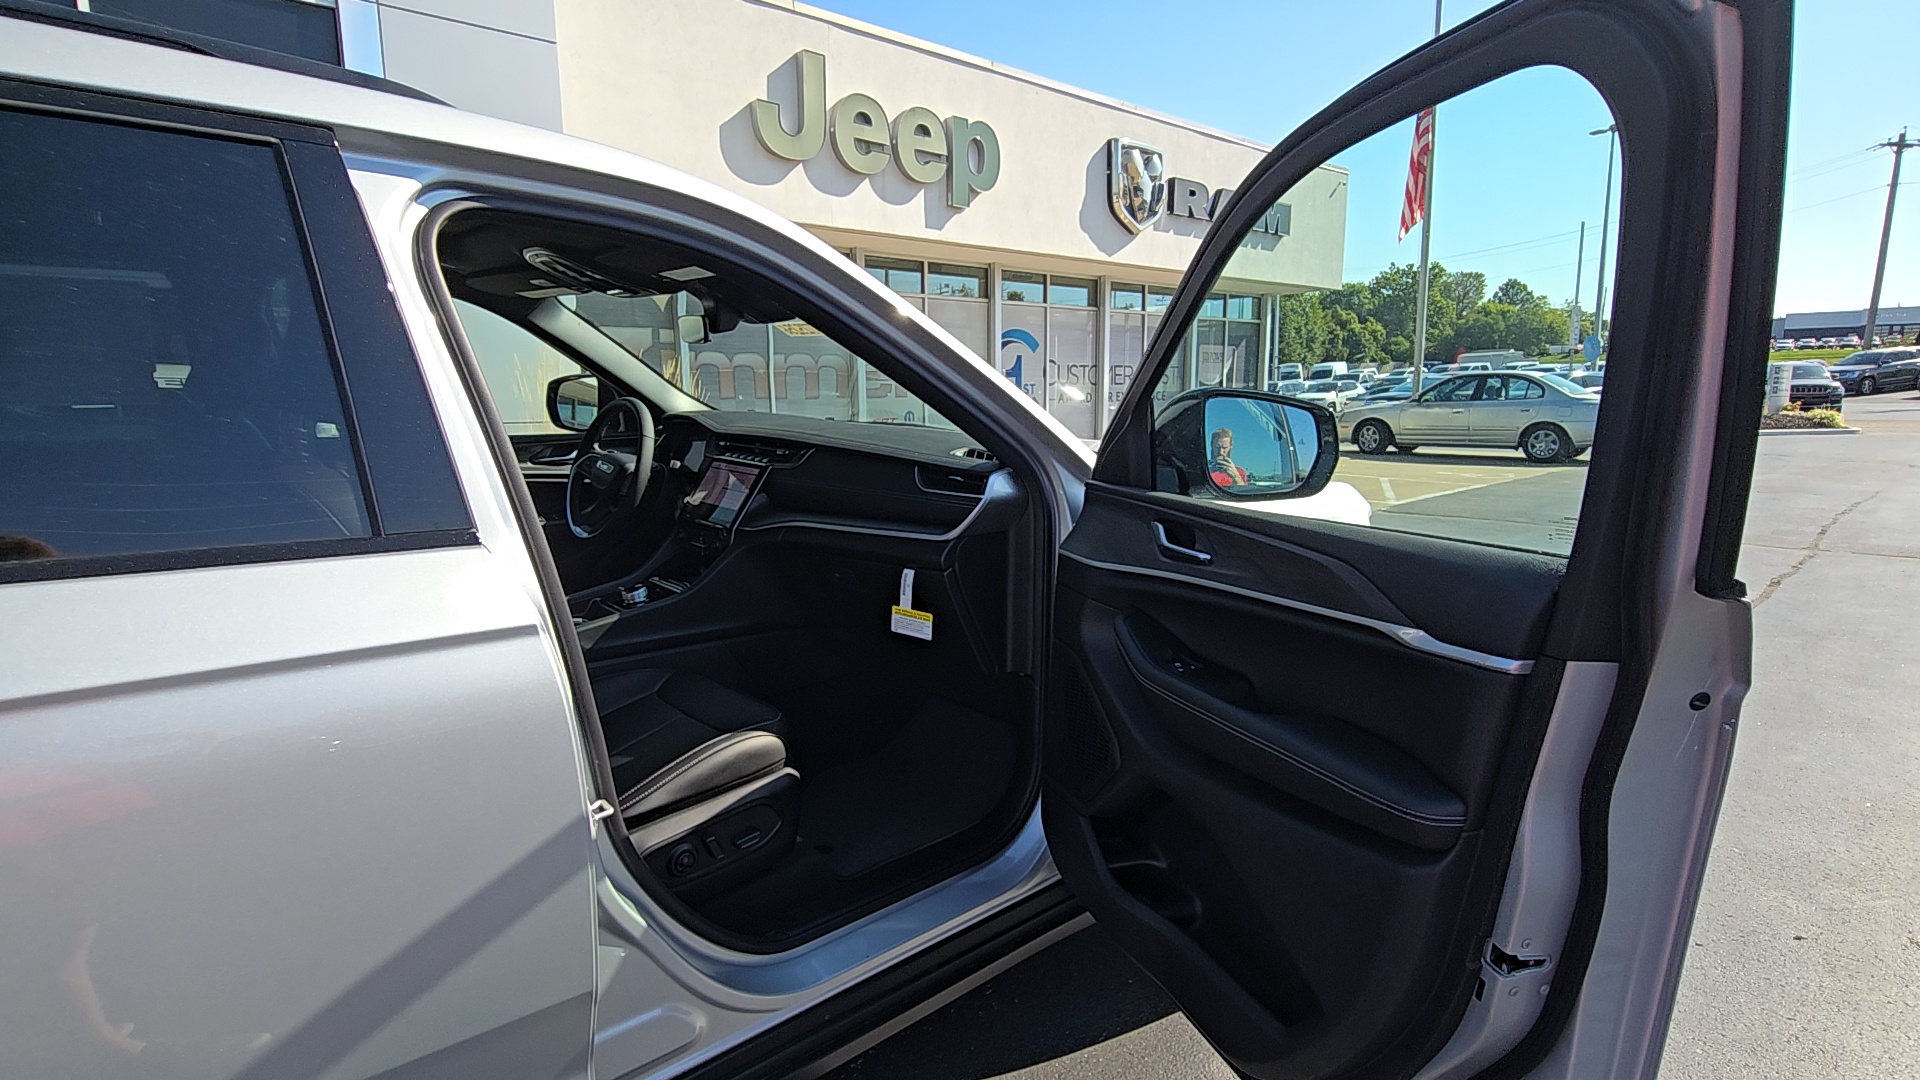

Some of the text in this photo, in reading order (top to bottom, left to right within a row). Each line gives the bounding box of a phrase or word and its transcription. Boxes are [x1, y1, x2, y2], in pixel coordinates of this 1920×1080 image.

[751, 48, 1001, 208] Jeep
[1166, 176, 1292, 237] RM
[598, 325, 914, 399] imme
